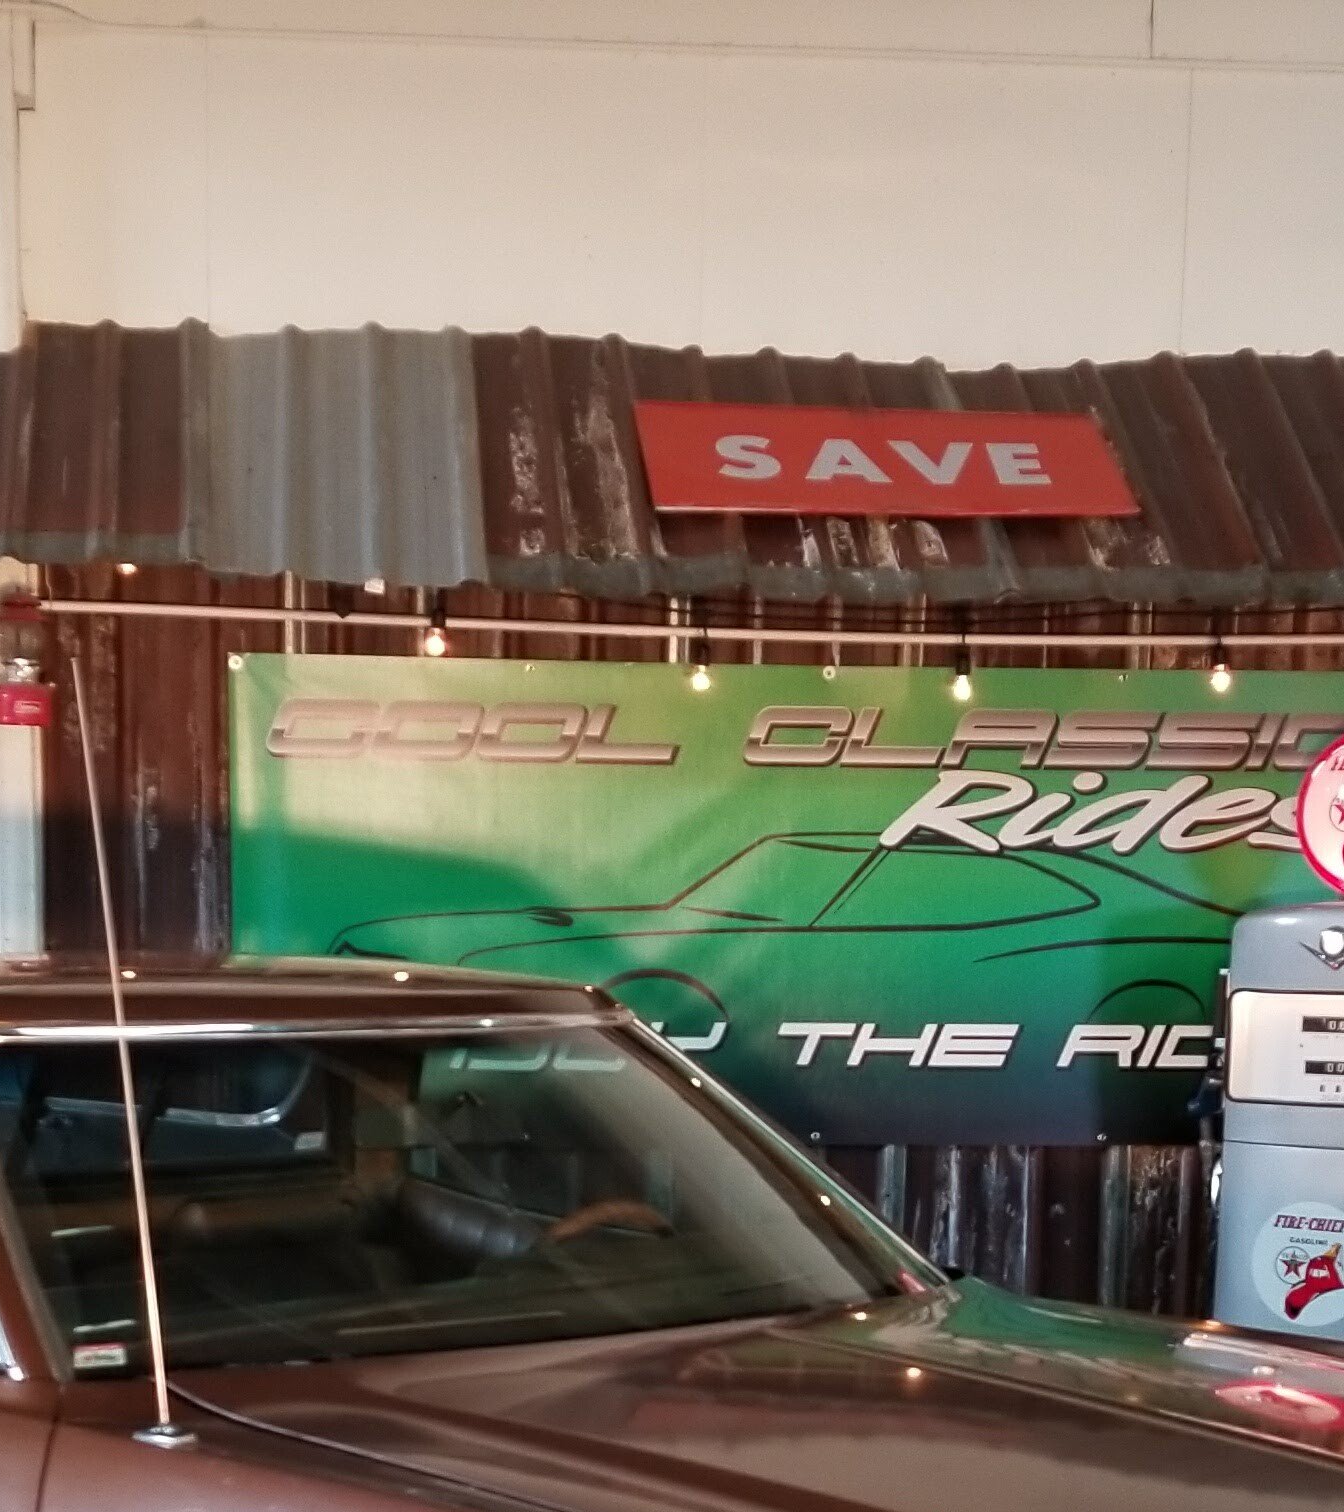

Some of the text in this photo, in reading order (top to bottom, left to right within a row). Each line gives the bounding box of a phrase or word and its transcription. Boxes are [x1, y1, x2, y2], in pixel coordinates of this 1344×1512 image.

[715, 434, 1052, 486] SAVE
[266, 698, 681, 766] COOL
[878, 768, 1304, 857] Rides
[777, 1022, 1022, 1068] THE
